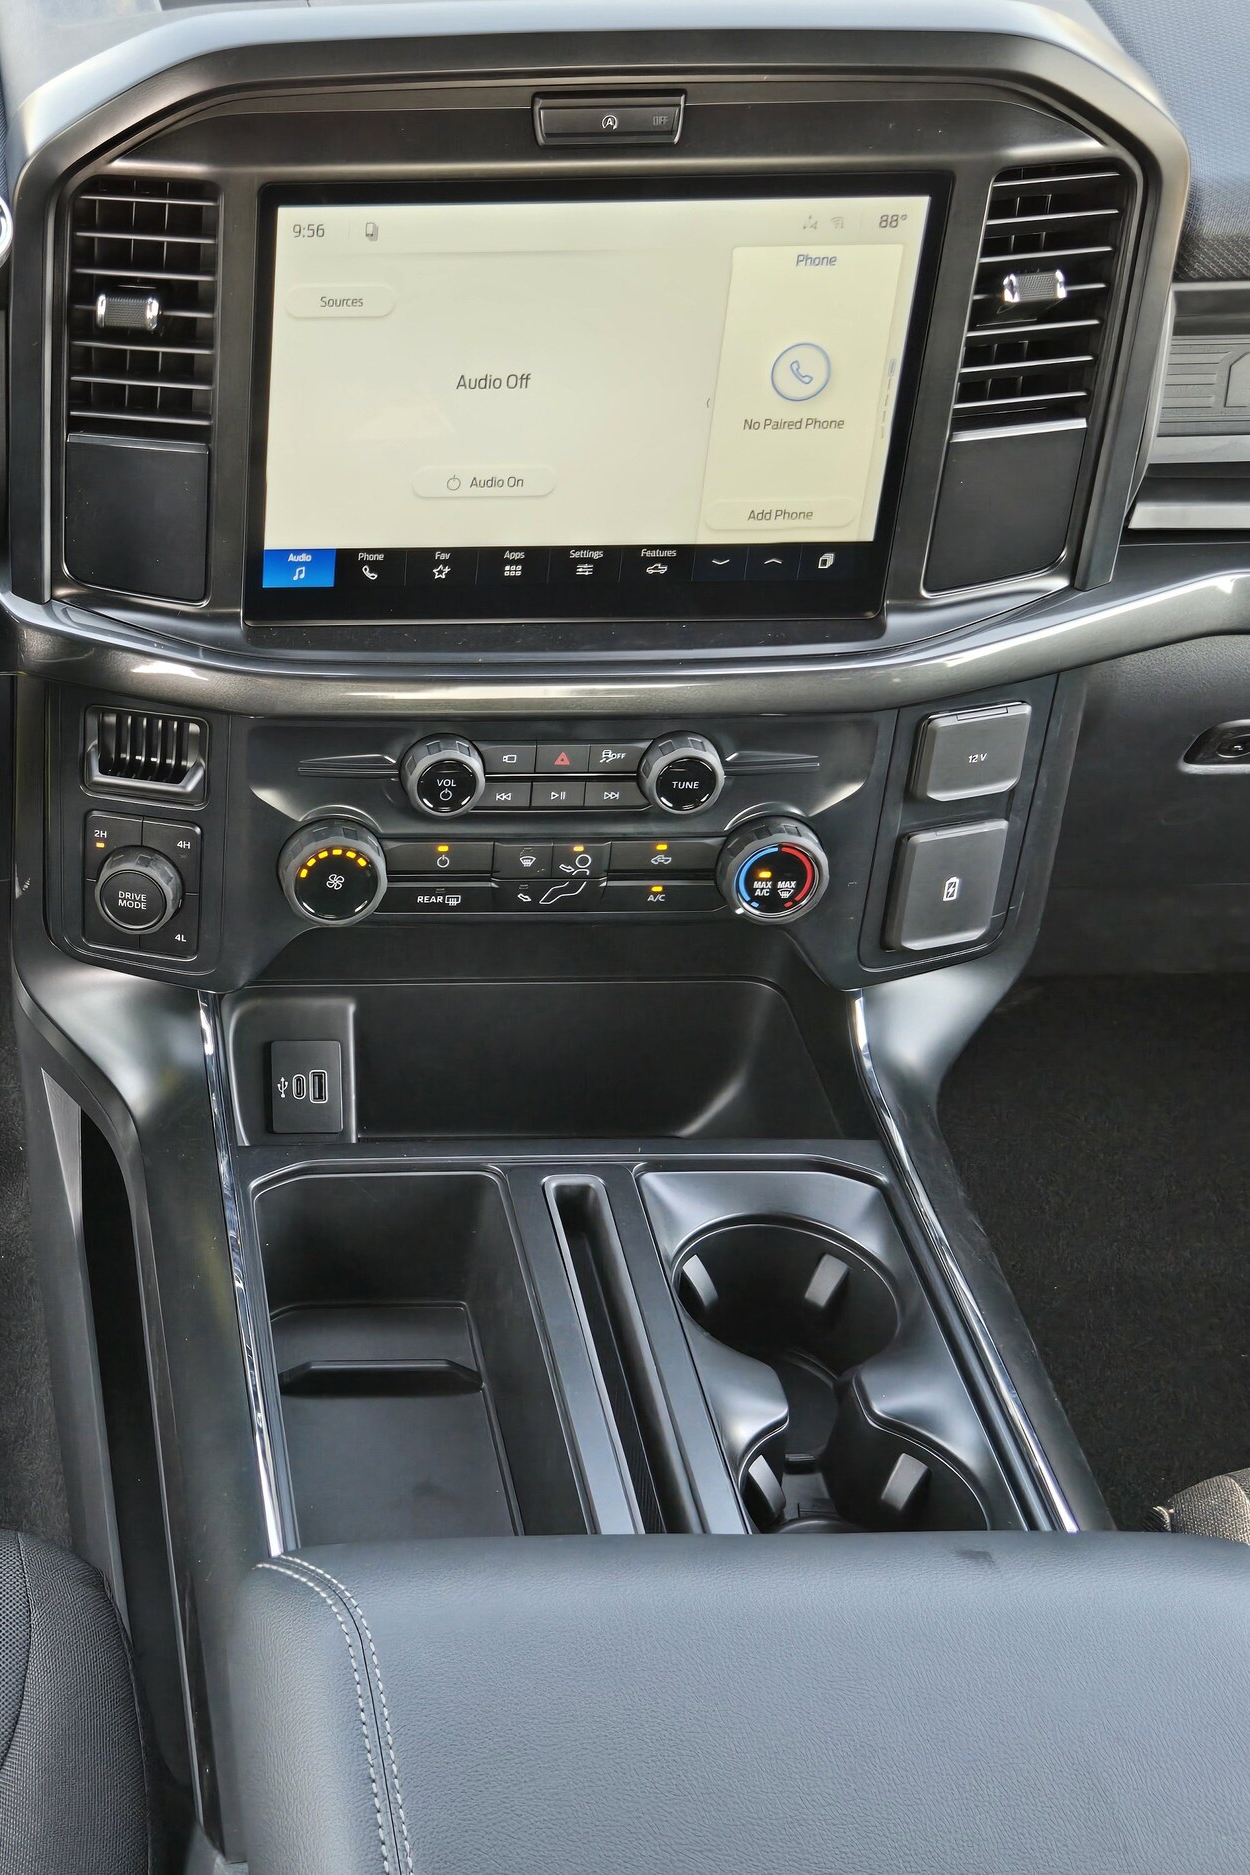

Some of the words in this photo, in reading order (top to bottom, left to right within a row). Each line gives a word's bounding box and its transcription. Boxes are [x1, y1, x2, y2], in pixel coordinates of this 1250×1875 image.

[878, 214, 908, 229] 88°
[293, 223, 325, 239] 9:56
[795, 254, 837, 267] Phone
[319, 296, 364, 308] Sources
[456, 374, 502, 390] Audio
[506, 373, 531, 390] Off
[743, 418, 761, 431] No
[763, 418, 803, 430] Paired
[805, 417, 845, 429] Phone
[470, 476, 504, 489] Audio
[507, 476, 524, 488] On
[748, 509, 771, 521] Add
[775, 509, 813, 521] Phone
[287, 552, 312, 563] Audio
[358, 552, 384, 561] Phone
[435, 551, 450, 560] Fav
[504, 550, 525, 561] Apps
[569, 549, 604, 560] Settings
[641, 549, 677, 558] Features
[611, 752, 627, 760] OFF
[968, 754, 979, 763] 12
[980, 752, 988, 762] V
[436, 778, 457, 787] VOL
[671, 780, 699, 789] TUNE
[94, 830, 107, 839] 2H
[177, 840, 191, 849] 4H
[753, 881, 772, 889] MAX
[777, 881, 797, 889] MAX
[118, 891, 147, 901] DRIVE
[754, 888, 770, 897] A/C
[417, 896, 443, 904] REAR
[647, 894, 665, 902] A/C
[118, 899, 147, 910] MODE
[175, 934, 187, 942] 4L
